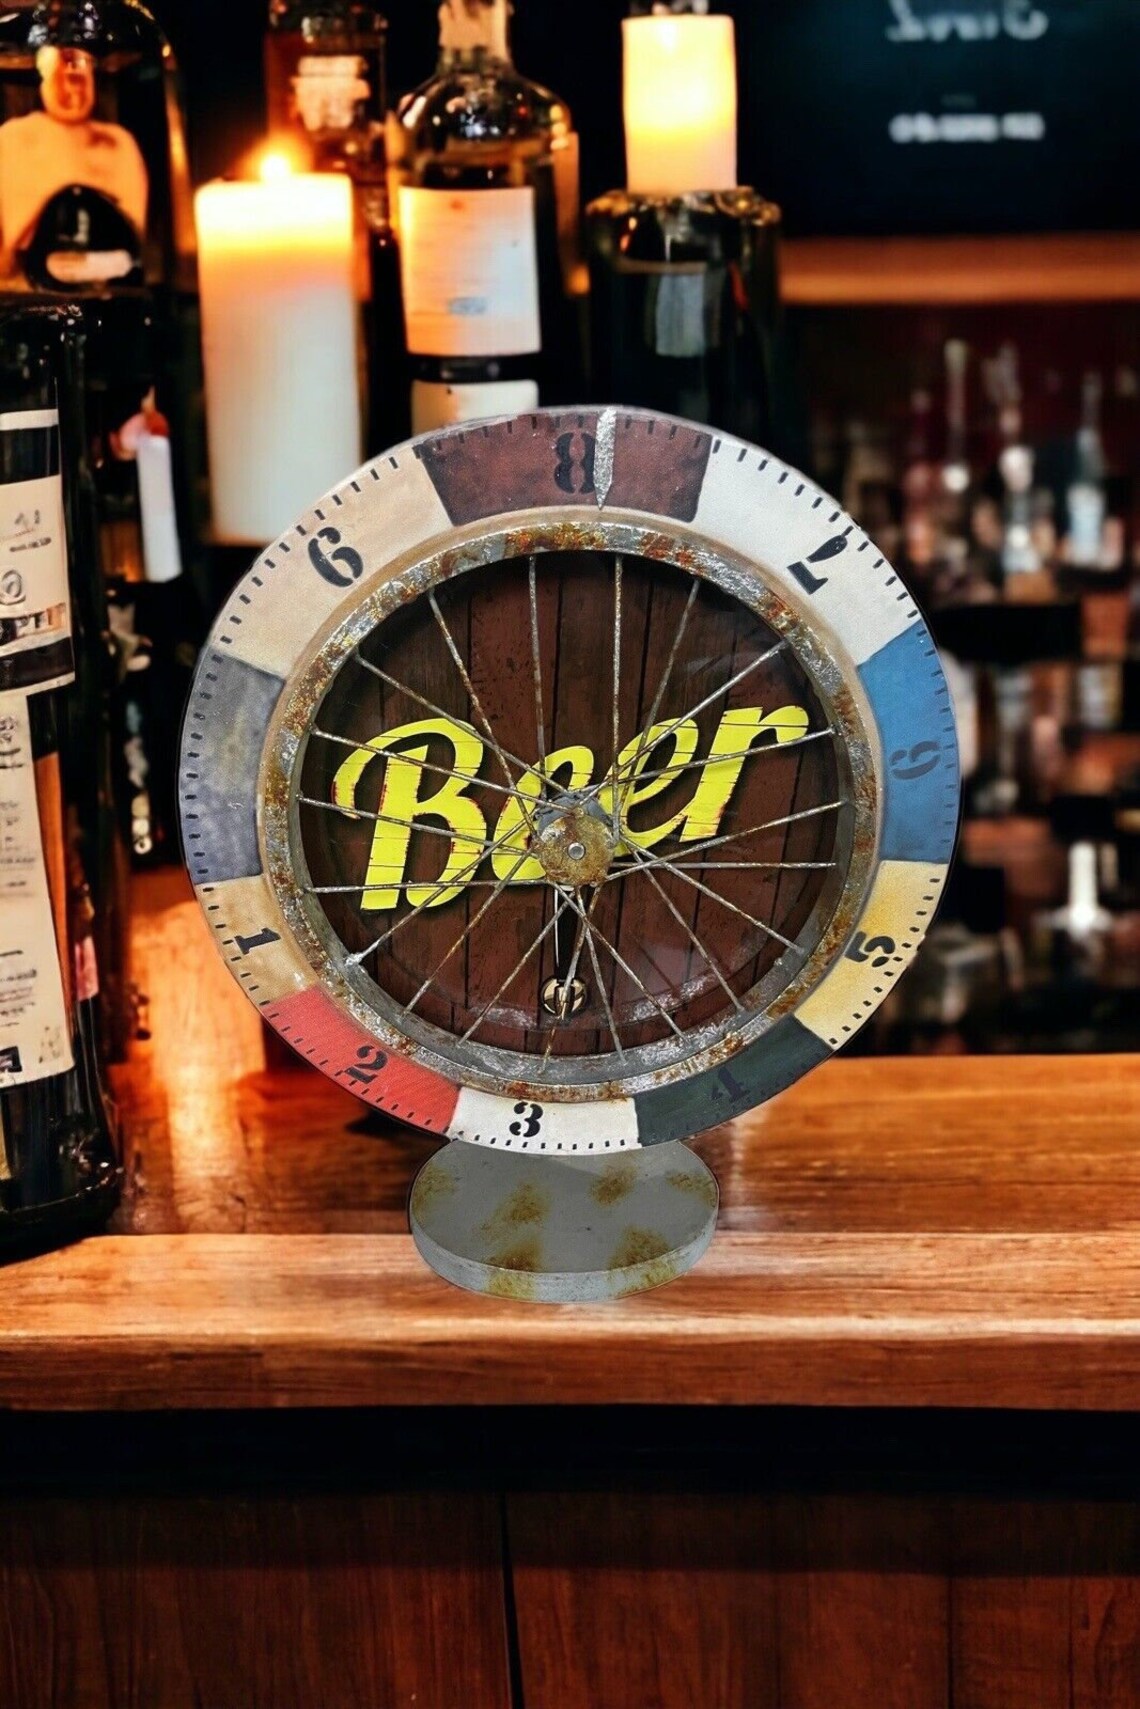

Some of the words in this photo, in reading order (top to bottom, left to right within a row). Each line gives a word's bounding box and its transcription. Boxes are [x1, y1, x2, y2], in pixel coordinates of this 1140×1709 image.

[553, 432, 596, 495] 8
[331, 705, 809, 910] Beer
[233, 927, 282, 955] 1
[844, 930, 896, 969] 5
[344, 1045, 389, 1084] 2
[508, 1101, 544, 1138] 3
